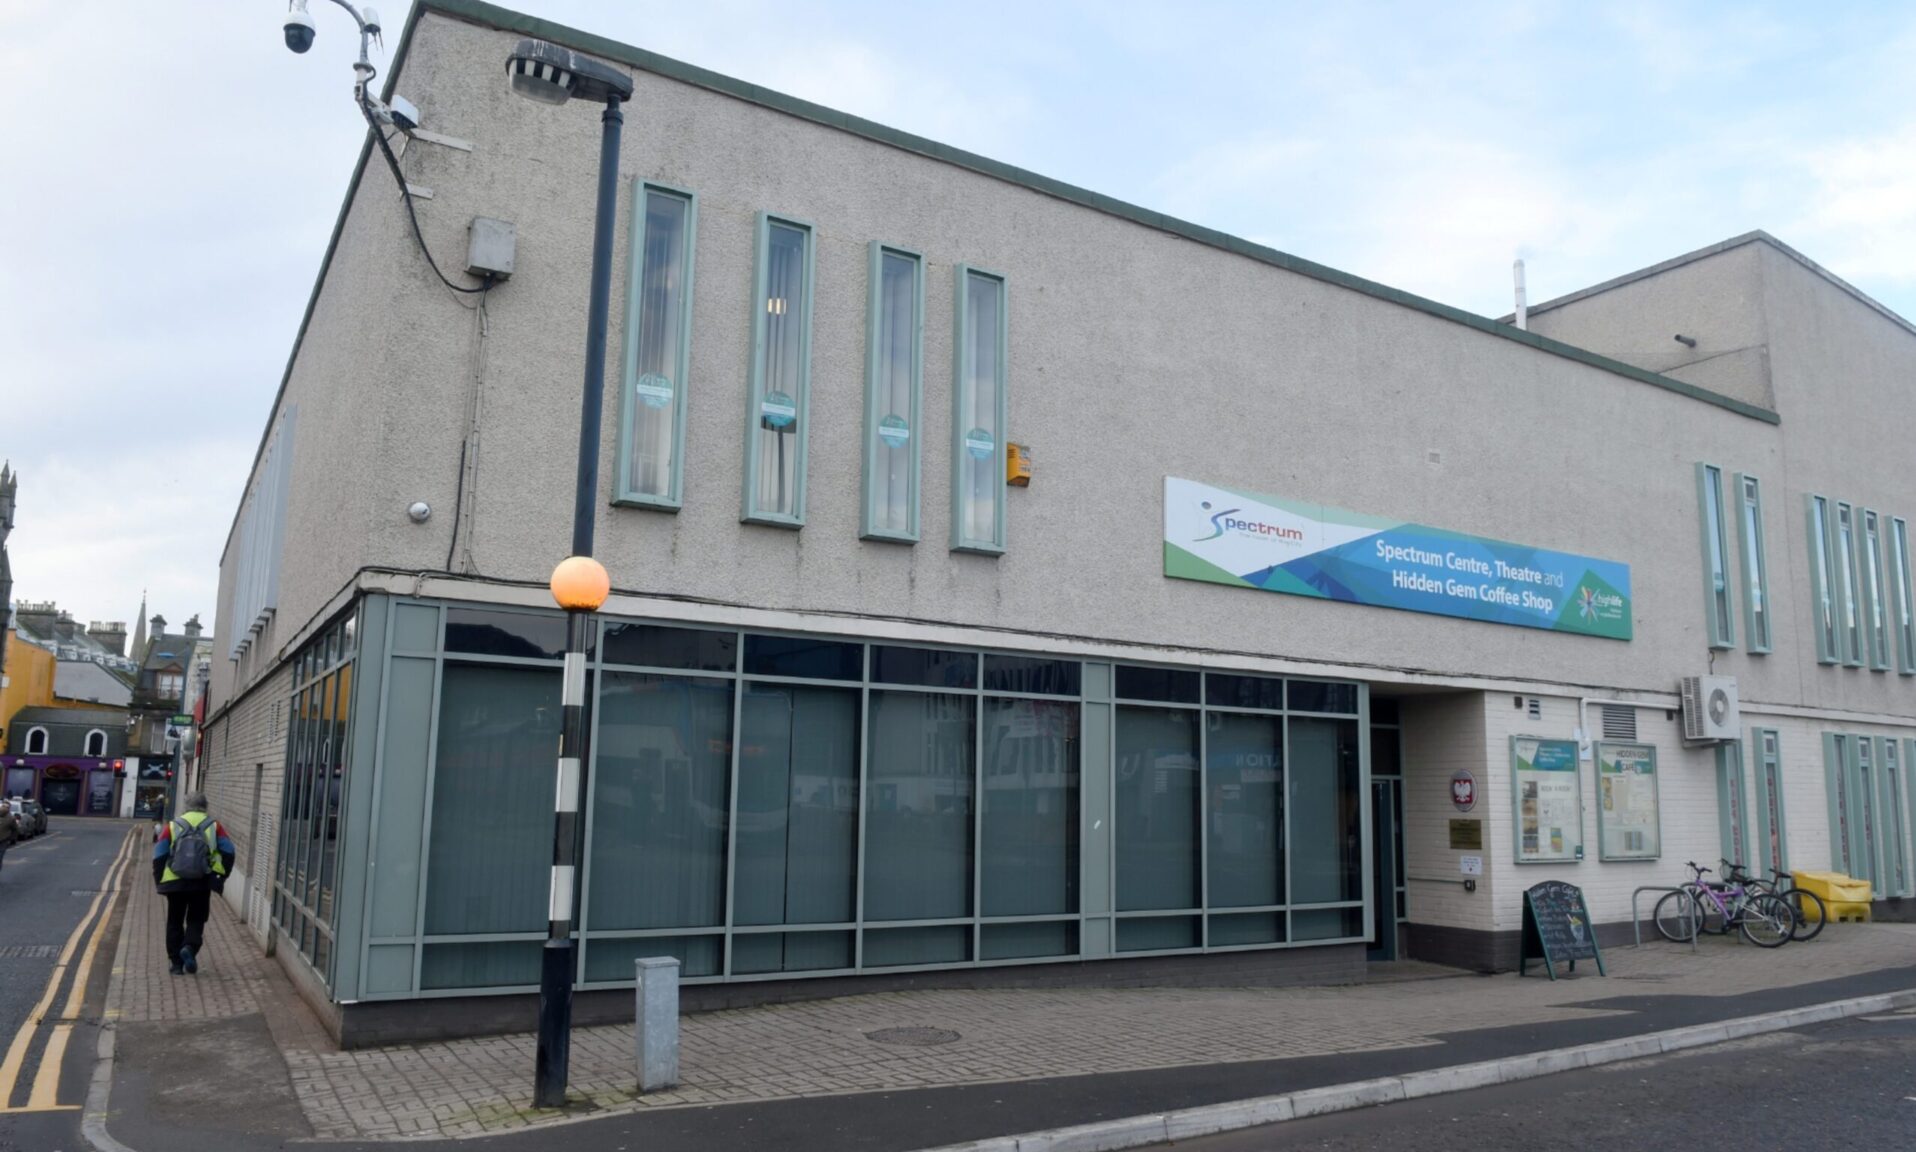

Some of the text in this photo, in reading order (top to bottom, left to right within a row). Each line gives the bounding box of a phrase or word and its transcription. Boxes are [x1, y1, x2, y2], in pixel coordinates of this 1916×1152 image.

[1191, 507, 1303, 543] Spectrum
[1376, 540, 1564, 588] Spectrum Centre, Theatre and
[1392, 569, 1553, 615] Hidden Gem Coffee Shop
